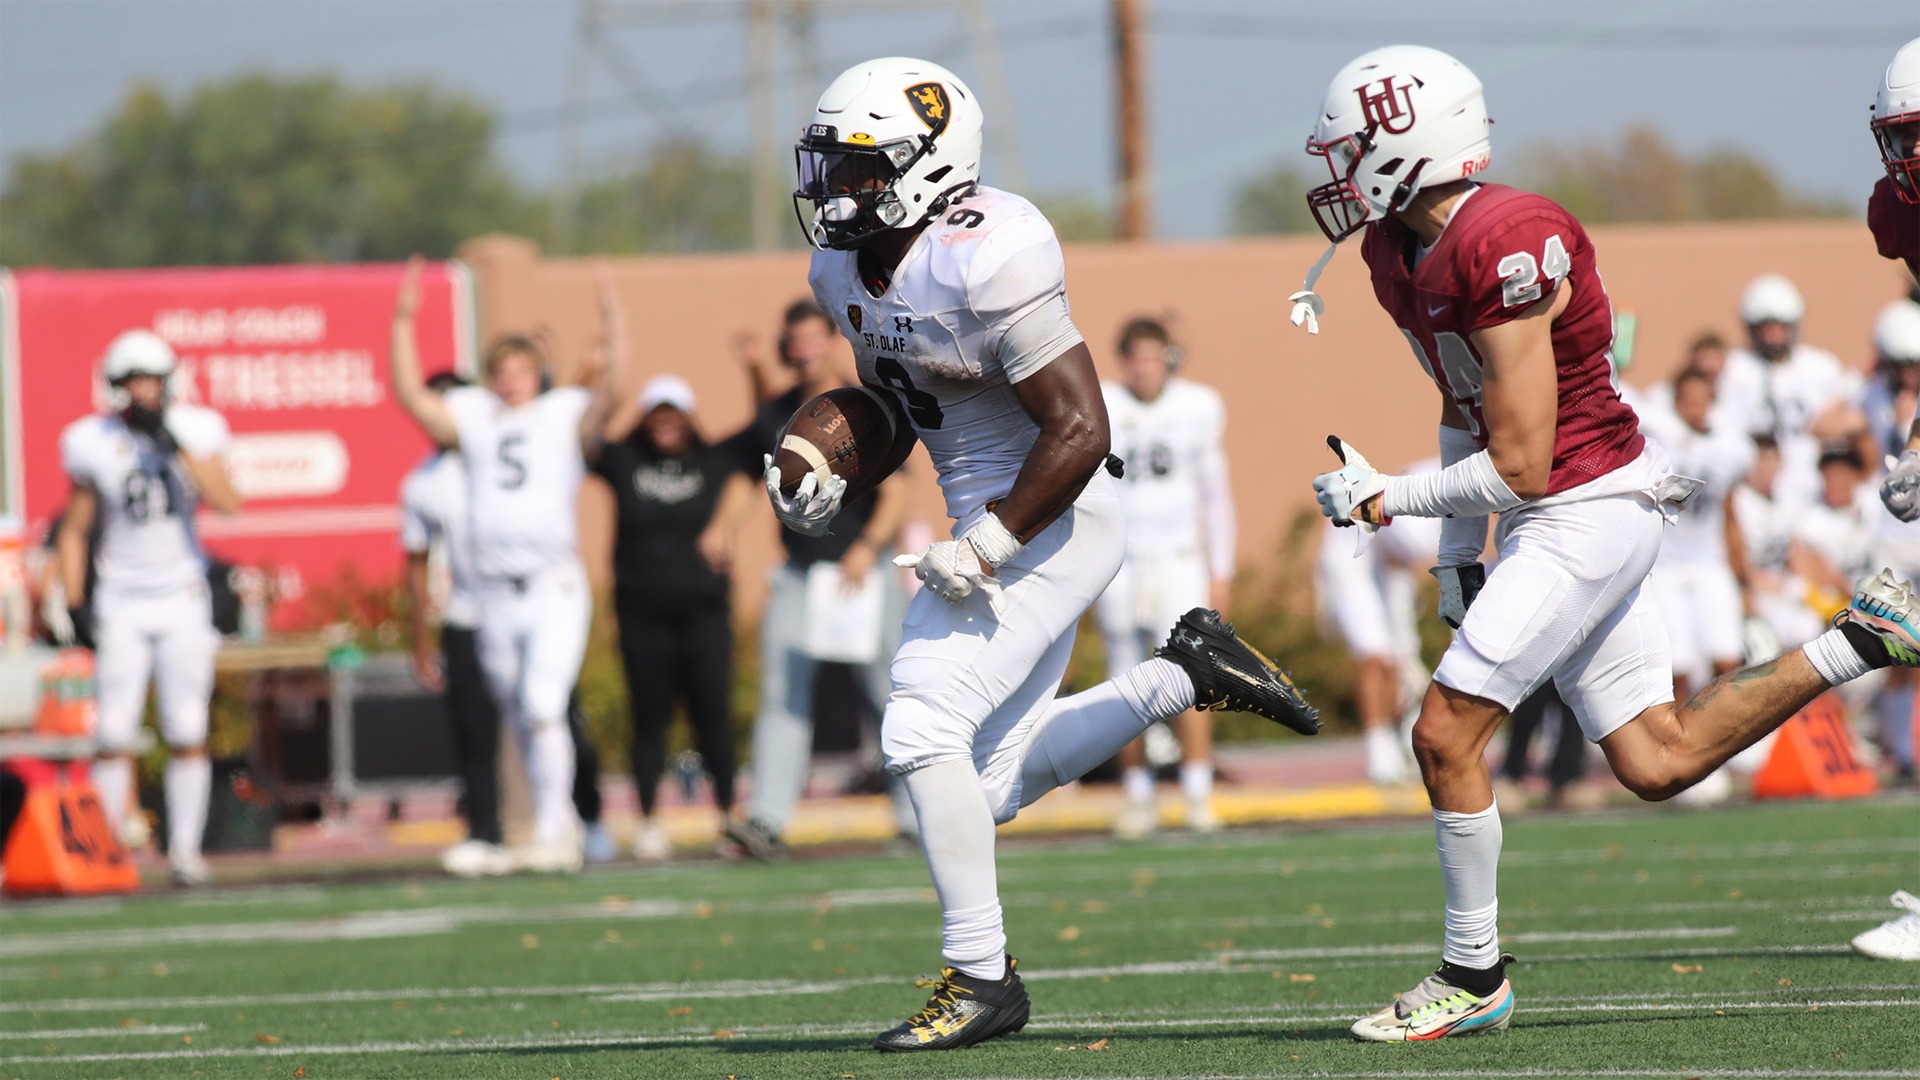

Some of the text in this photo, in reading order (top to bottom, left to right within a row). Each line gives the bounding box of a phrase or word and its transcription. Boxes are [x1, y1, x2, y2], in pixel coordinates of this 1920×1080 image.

[1353, 75, 1415, 135] HU
[947, 208, 985, 229] 9
[1497, 234, 1571, 308] 24
[864, 332, 905, 352] ST. OLAF
[497, 433, 528, 492] 5
